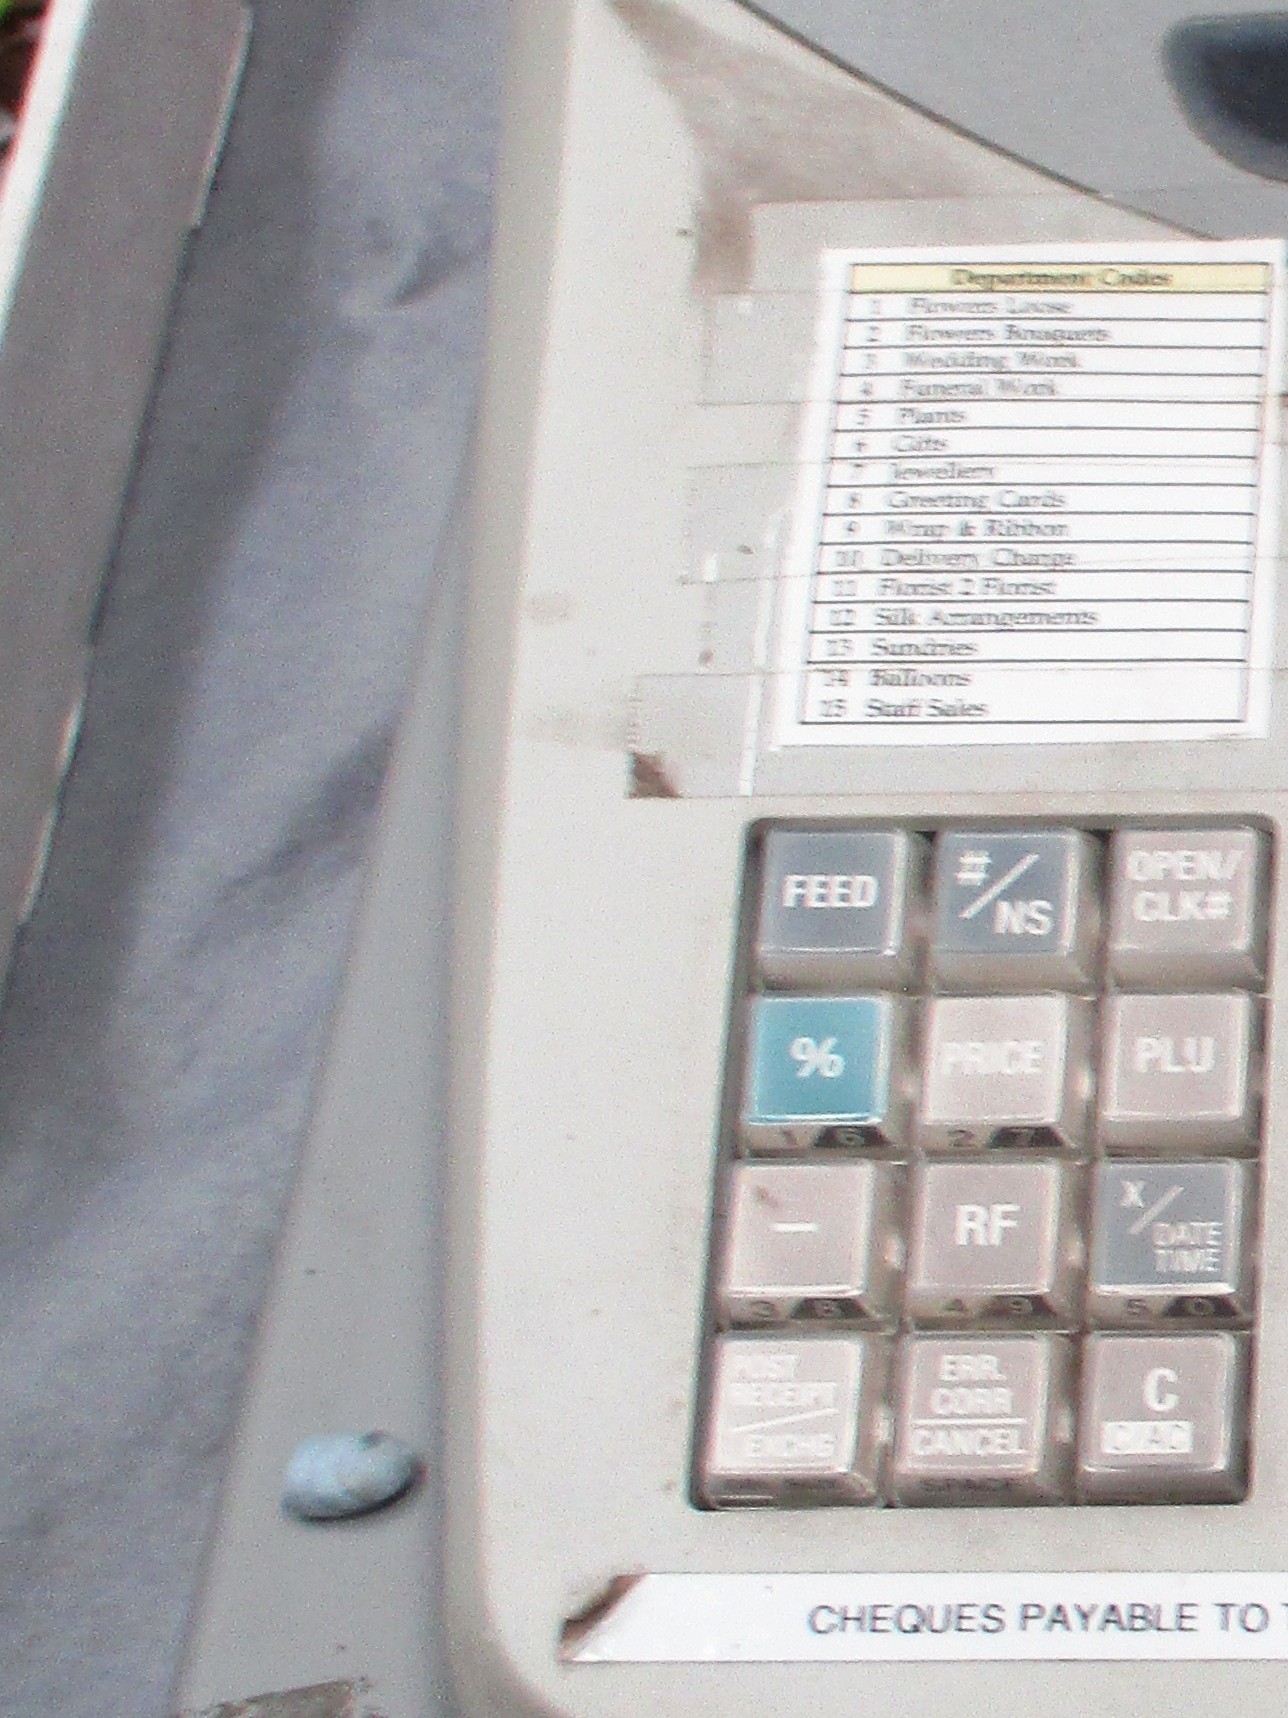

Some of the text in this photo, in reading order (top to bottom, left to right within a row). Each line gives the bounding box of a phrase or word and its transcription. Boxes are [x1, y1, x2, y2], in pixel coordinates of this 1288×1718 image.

[949, 267, 1175, 291] Department Codes
[905, 297, 998, 316] Flowers
[1005, 297, 1075, 315] Loose
[903, 325, 996, 342] Flowers
[1003, 324, 1111, 345] Bouquets
[902, 353, 1007, 372] Wedding
[899, 379, 987, 398] Funeral
[896, 407, 968, 425] Plants
[890, 435, 949, 452] Gifts
[885, 490, 991, 512] Greeting
[999, 490, 1068, 509] Cards
[983, 519, 1071, 538] Ribbon
[879, 548, 980, 570] Delivery
[991, 547, 1078, 569] Charge
[872, 607, 917, 627] Silk
[927, 608, 1099, 630] Arrangements
[868, 637, 979, 658] Sundries
[867, 667, 972, 688] Balloons
[926, 697, 989, 718] Sales
[782, 873, 877, 910] FEED
[1131, 890, 1233, 924] CLK#
[789, 1036, 844, 1079] %
[940, 1040, 1043, 1077] PRICE
[1133, 1035, 1216, 1075] PLU
[946, 1128, 972, 1149] 2
[953, 1205, 1020, 1246] RF
[1151, 1221, 1222, 1248] DATE
[1155, 1248, 1220, 1274] TIME
[929, 1387, 1014, 1416] CORR
[1143, 1367, 1179, 1413] C
[910, 1423, 1028, 1457] CANCEL
[808, 1602, 1006, 1635] CHEQUES
[1017, 1601, 1201, 1633] PAYABLE
[1214, 1600, 1270, 1633] TO
